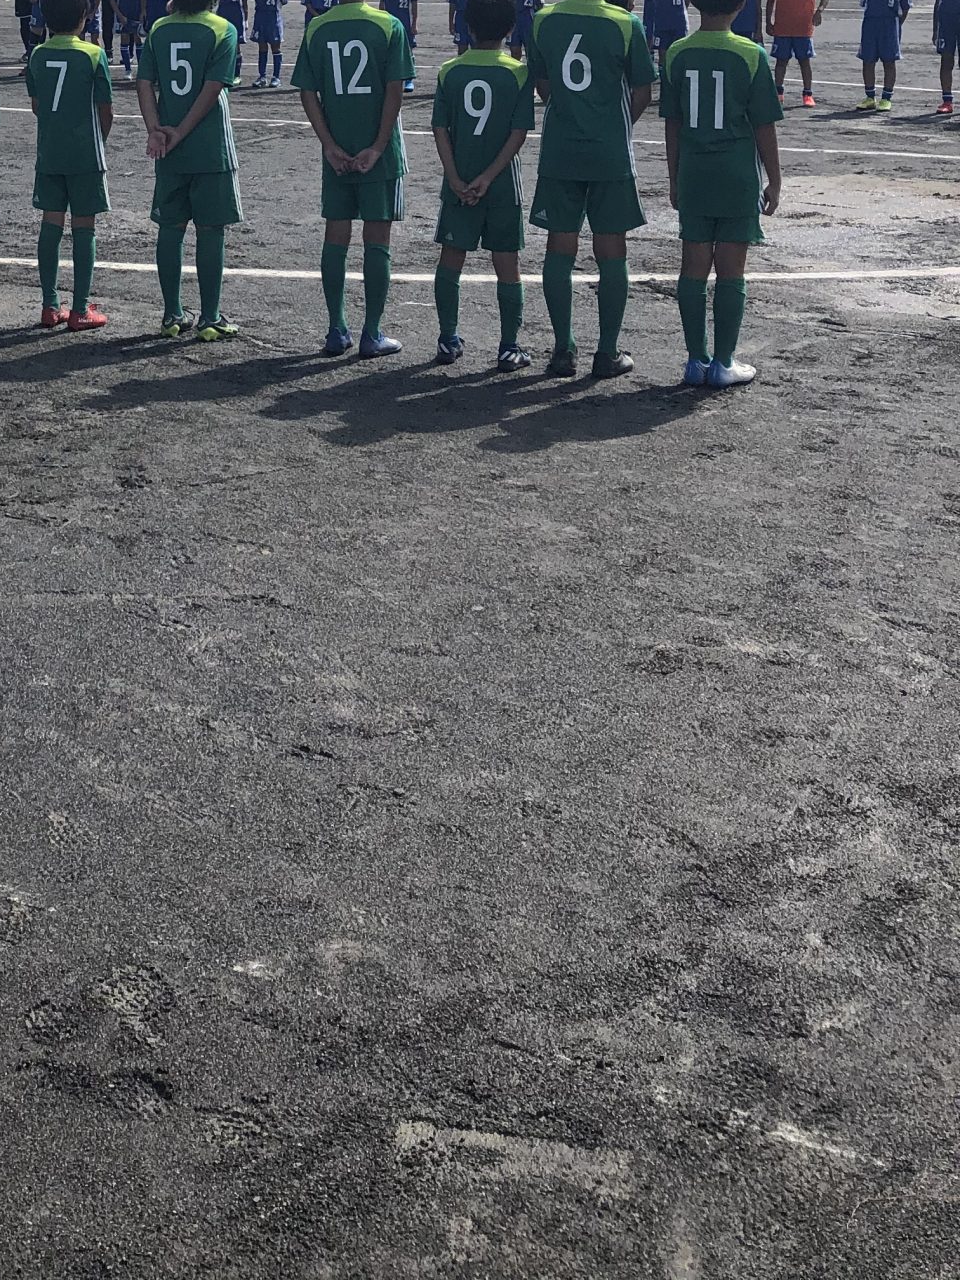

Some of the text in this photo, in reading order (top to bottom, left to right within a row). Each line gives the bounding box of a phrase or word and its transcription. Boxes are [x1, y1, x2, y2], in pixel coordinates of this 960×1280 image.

[399, 0, 409, 9] 22
[45, 60, 68, 112] 7
[169, 42, 193, 96] 5
[326, 39, 372, 95] 12
[561, 33, 592, 92] 6
[463, 79, 492, 136] 9
[685, 69, 724, 130] 11
